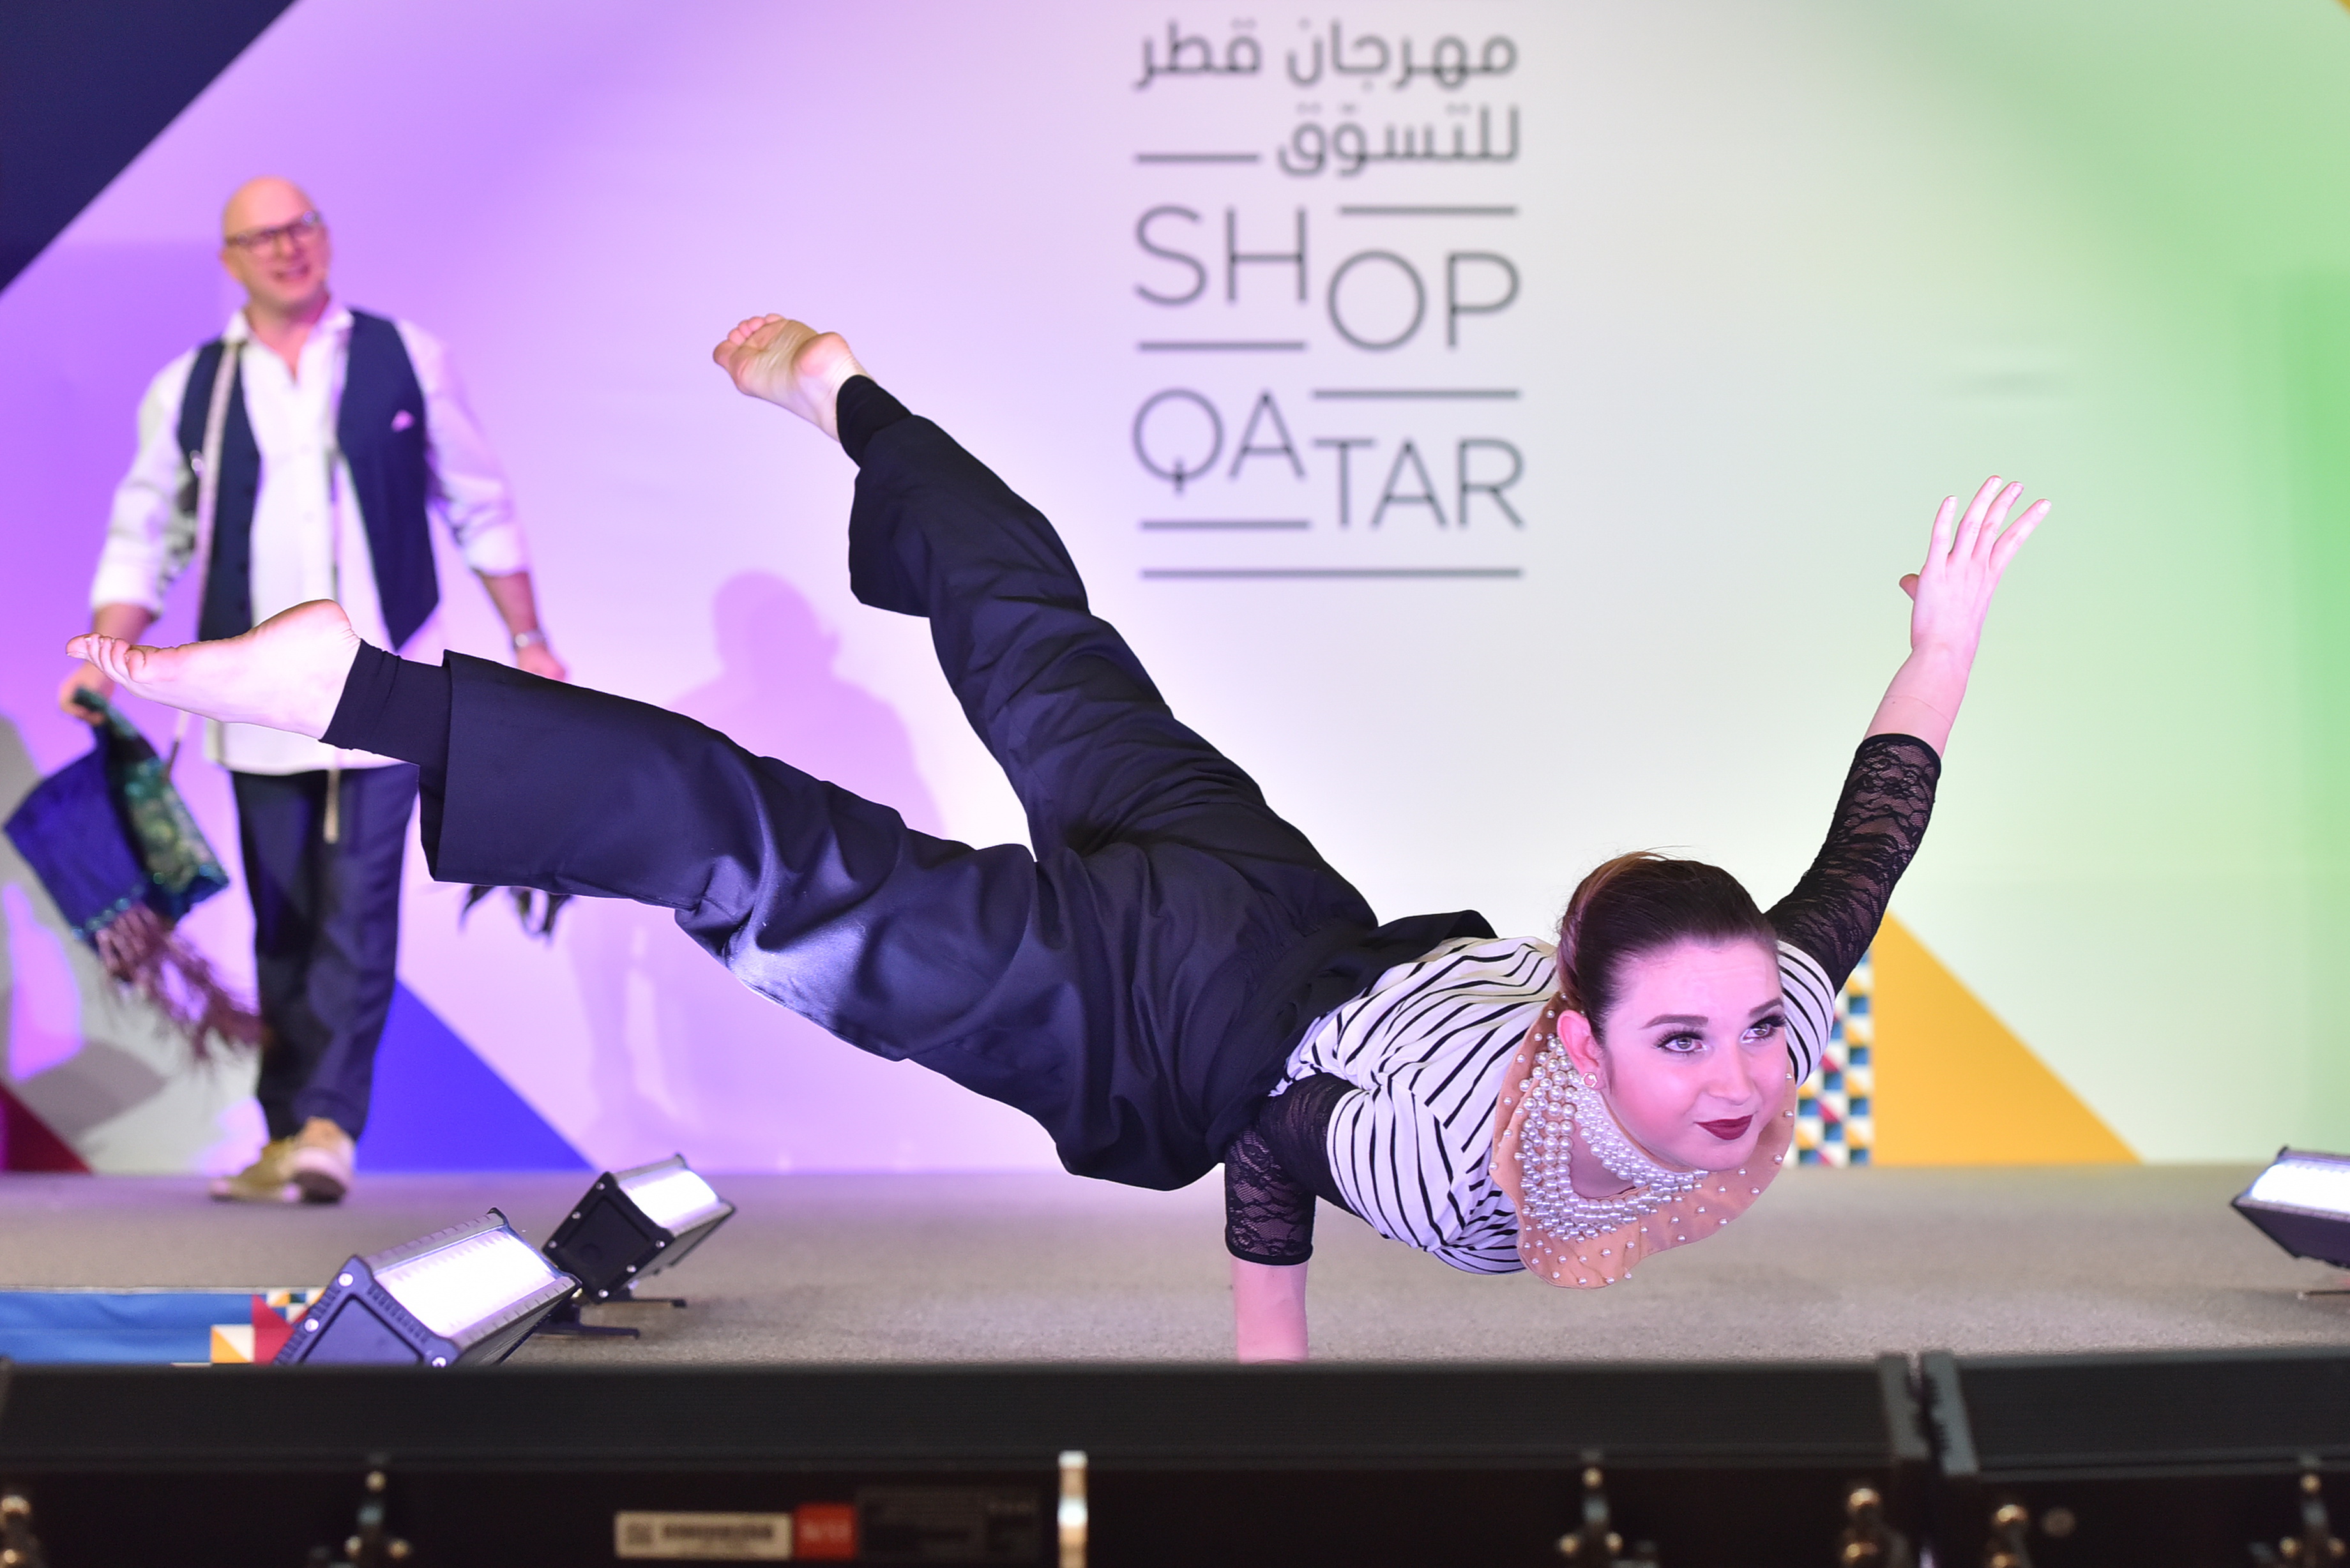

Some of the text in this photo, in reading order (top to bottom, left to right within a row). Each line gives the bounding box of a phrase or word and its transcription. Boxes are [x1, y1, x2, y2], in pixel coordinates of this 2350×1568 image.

[1132, 19, 1519, 93] مهرجان قطر
[1133, 204, 1522, 354] SHOP
[1130, 387, 1526, 530] QATAR
